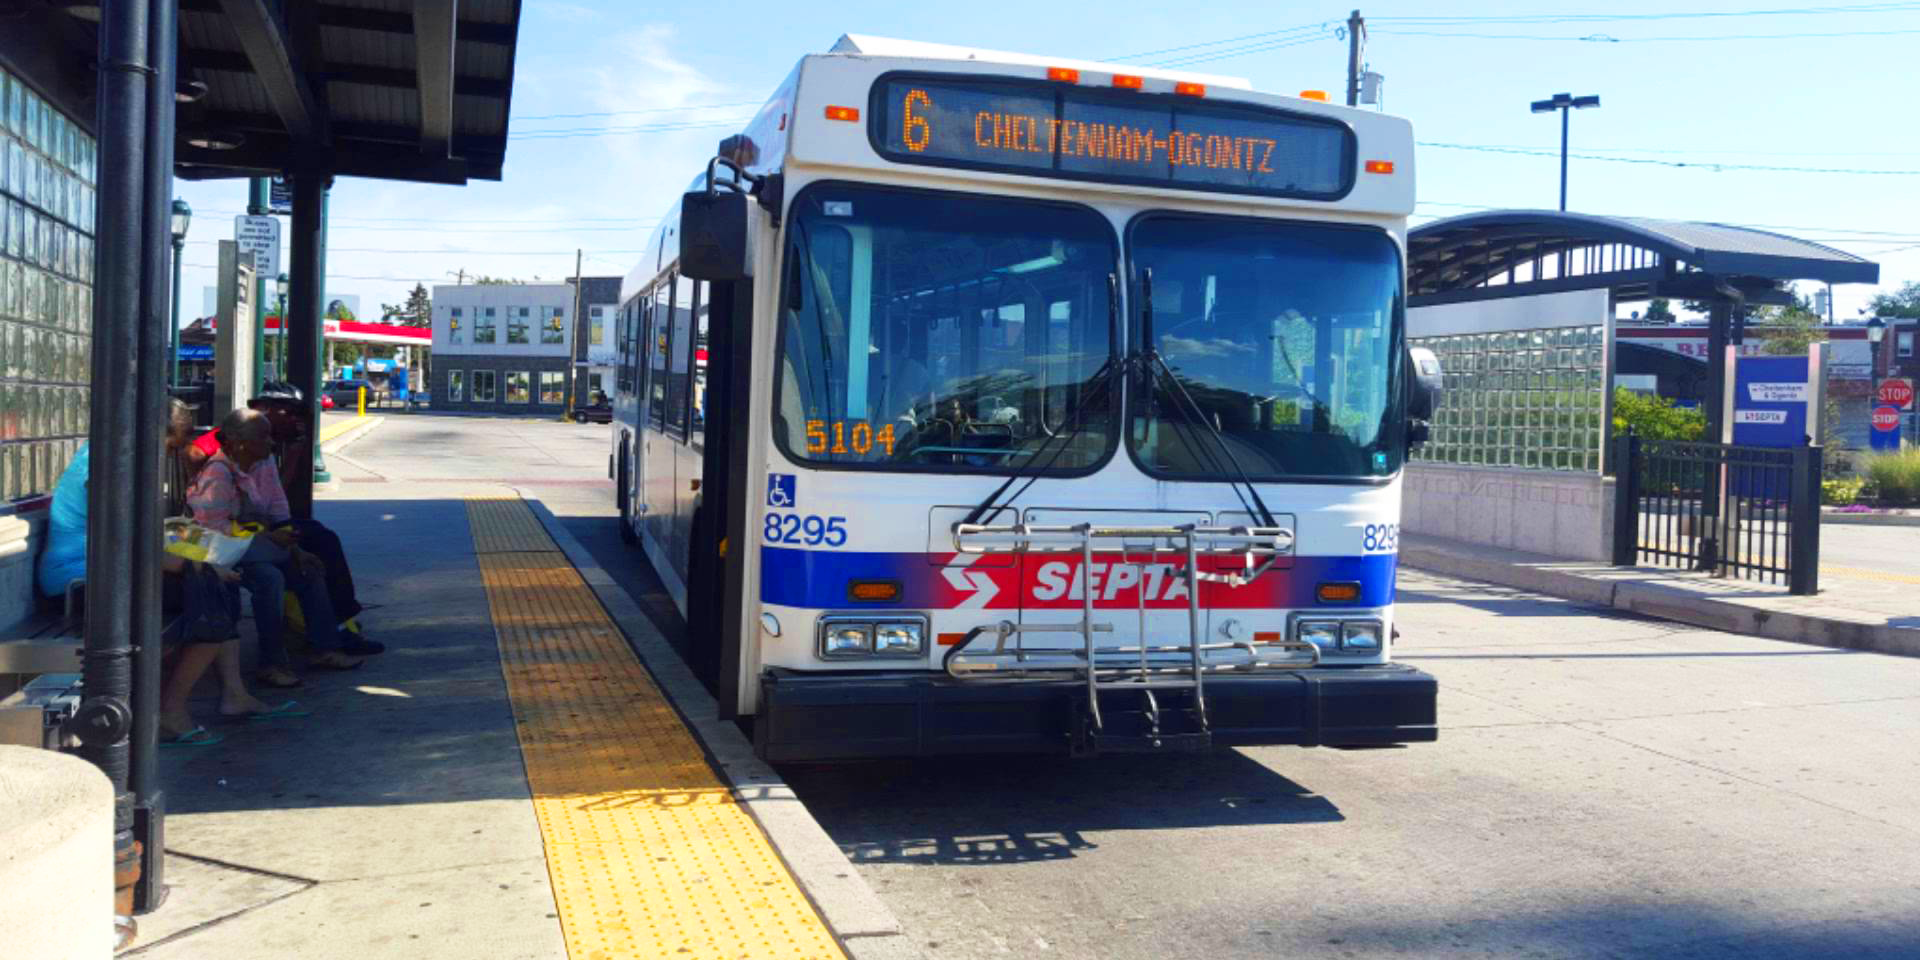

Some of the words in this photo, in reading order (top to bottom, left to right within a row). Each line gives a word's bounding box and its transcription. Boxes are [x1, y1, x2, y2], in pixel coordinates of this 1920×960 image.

[904, 89, 931, 152] 6
[975, 110, 1277, 173] CHELTENHAM-OGONTZ
[1879, 387, 1911, 401] STOP
[1873, 414, 1899, 423] STOP
[805, 419, 896, 456] 5104
[764, 512, 848, 547] 8295
[1032, 561, 1190, 601] SEPTA
